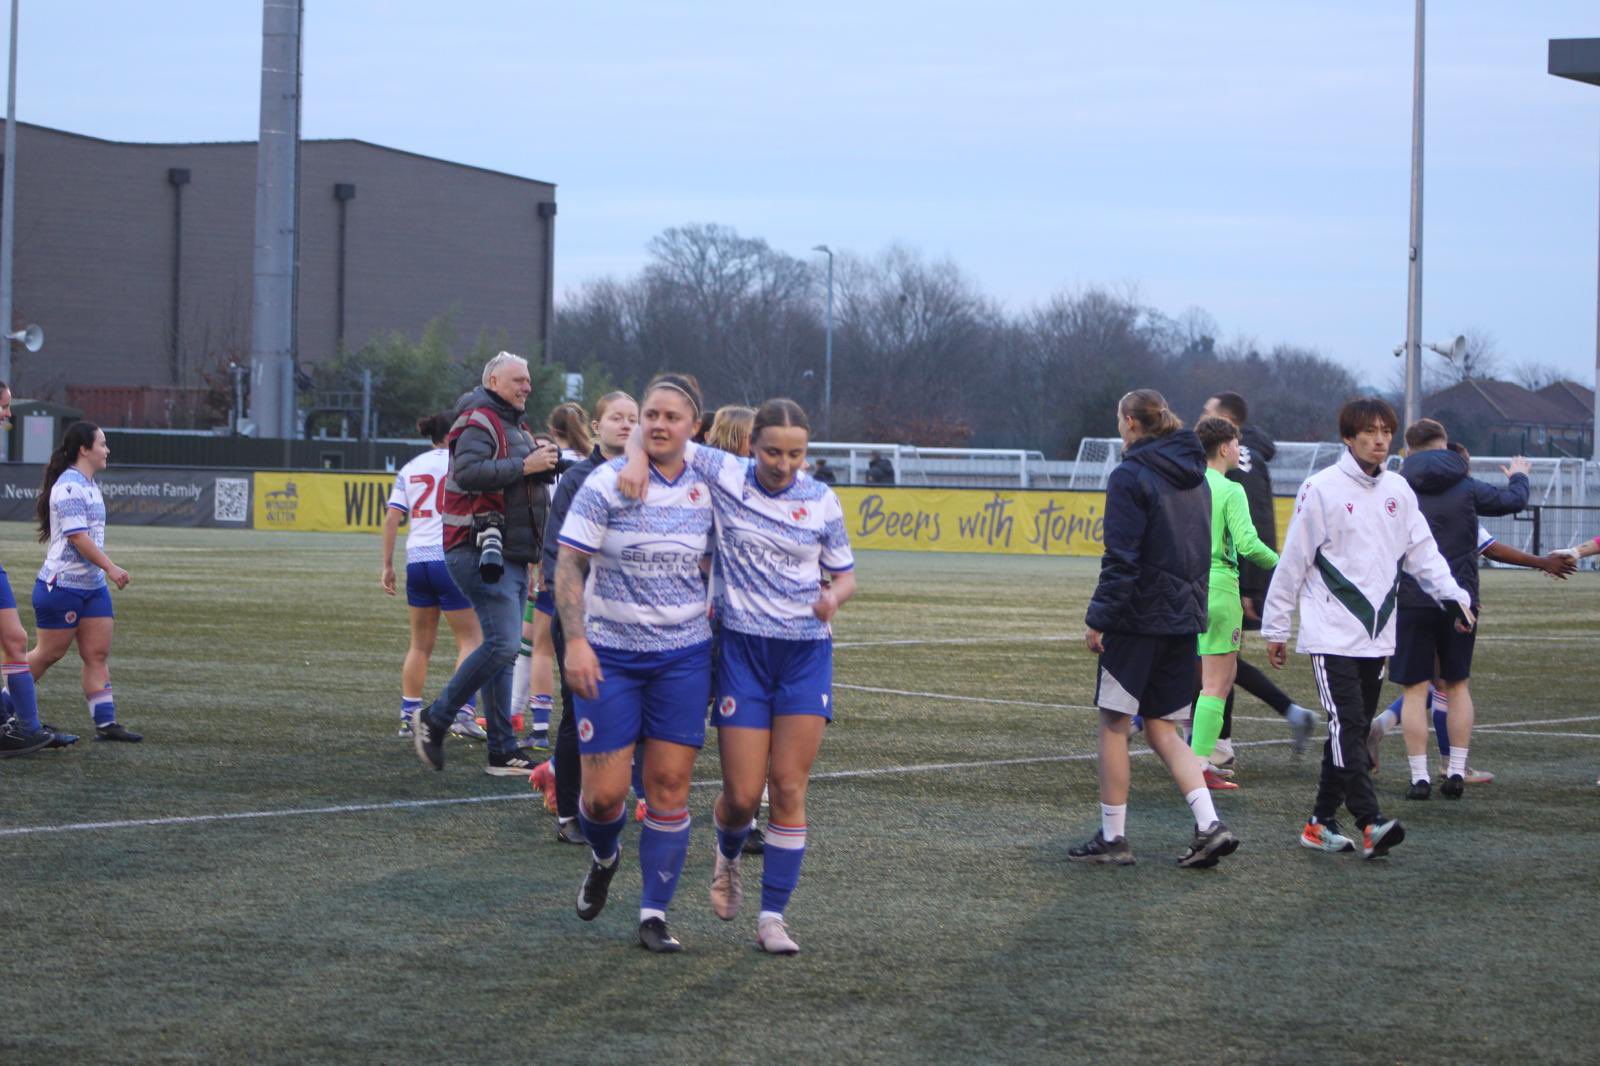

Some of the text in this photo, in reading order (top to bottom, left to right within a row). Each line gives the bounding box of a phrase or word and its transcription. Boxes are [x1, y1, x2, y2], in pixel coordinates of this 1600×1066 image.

[163, 482, 202, 501] Family
[856, 491, 1105, 551] Beers with storie
[620, 549, 681, 564] SELECT
